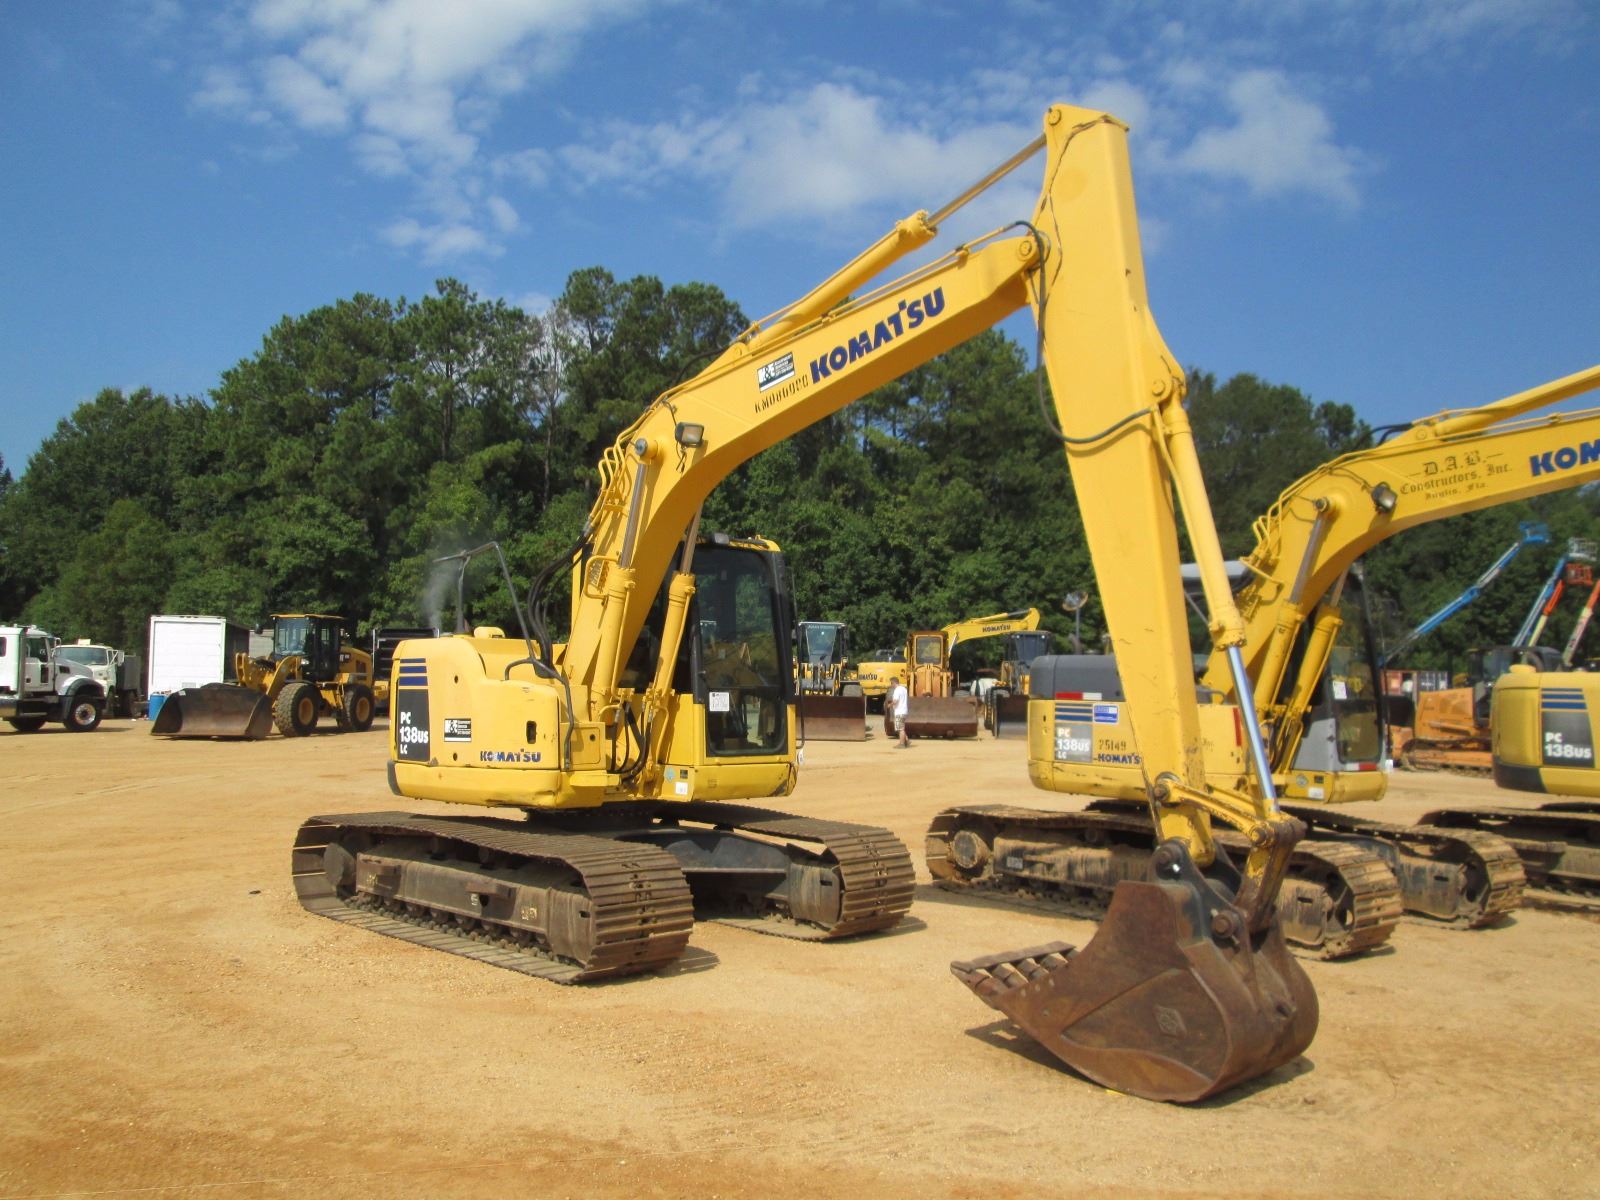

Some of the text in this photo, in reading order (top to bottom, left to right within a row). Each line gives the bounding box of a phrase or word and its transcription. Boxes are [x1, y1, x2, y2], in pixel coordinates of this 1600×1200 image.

[809, 286, 945, 385] KOMATSU
[400, 711, 411, 725] PC
[1057, 726, 1071, 738] PC
[1544, 731, 1563, 743] PC
[400, 743, 408, 755] LC
[480, 748, 542, 763] KOMATSU
[1057, 751, 1067, 760] LC
